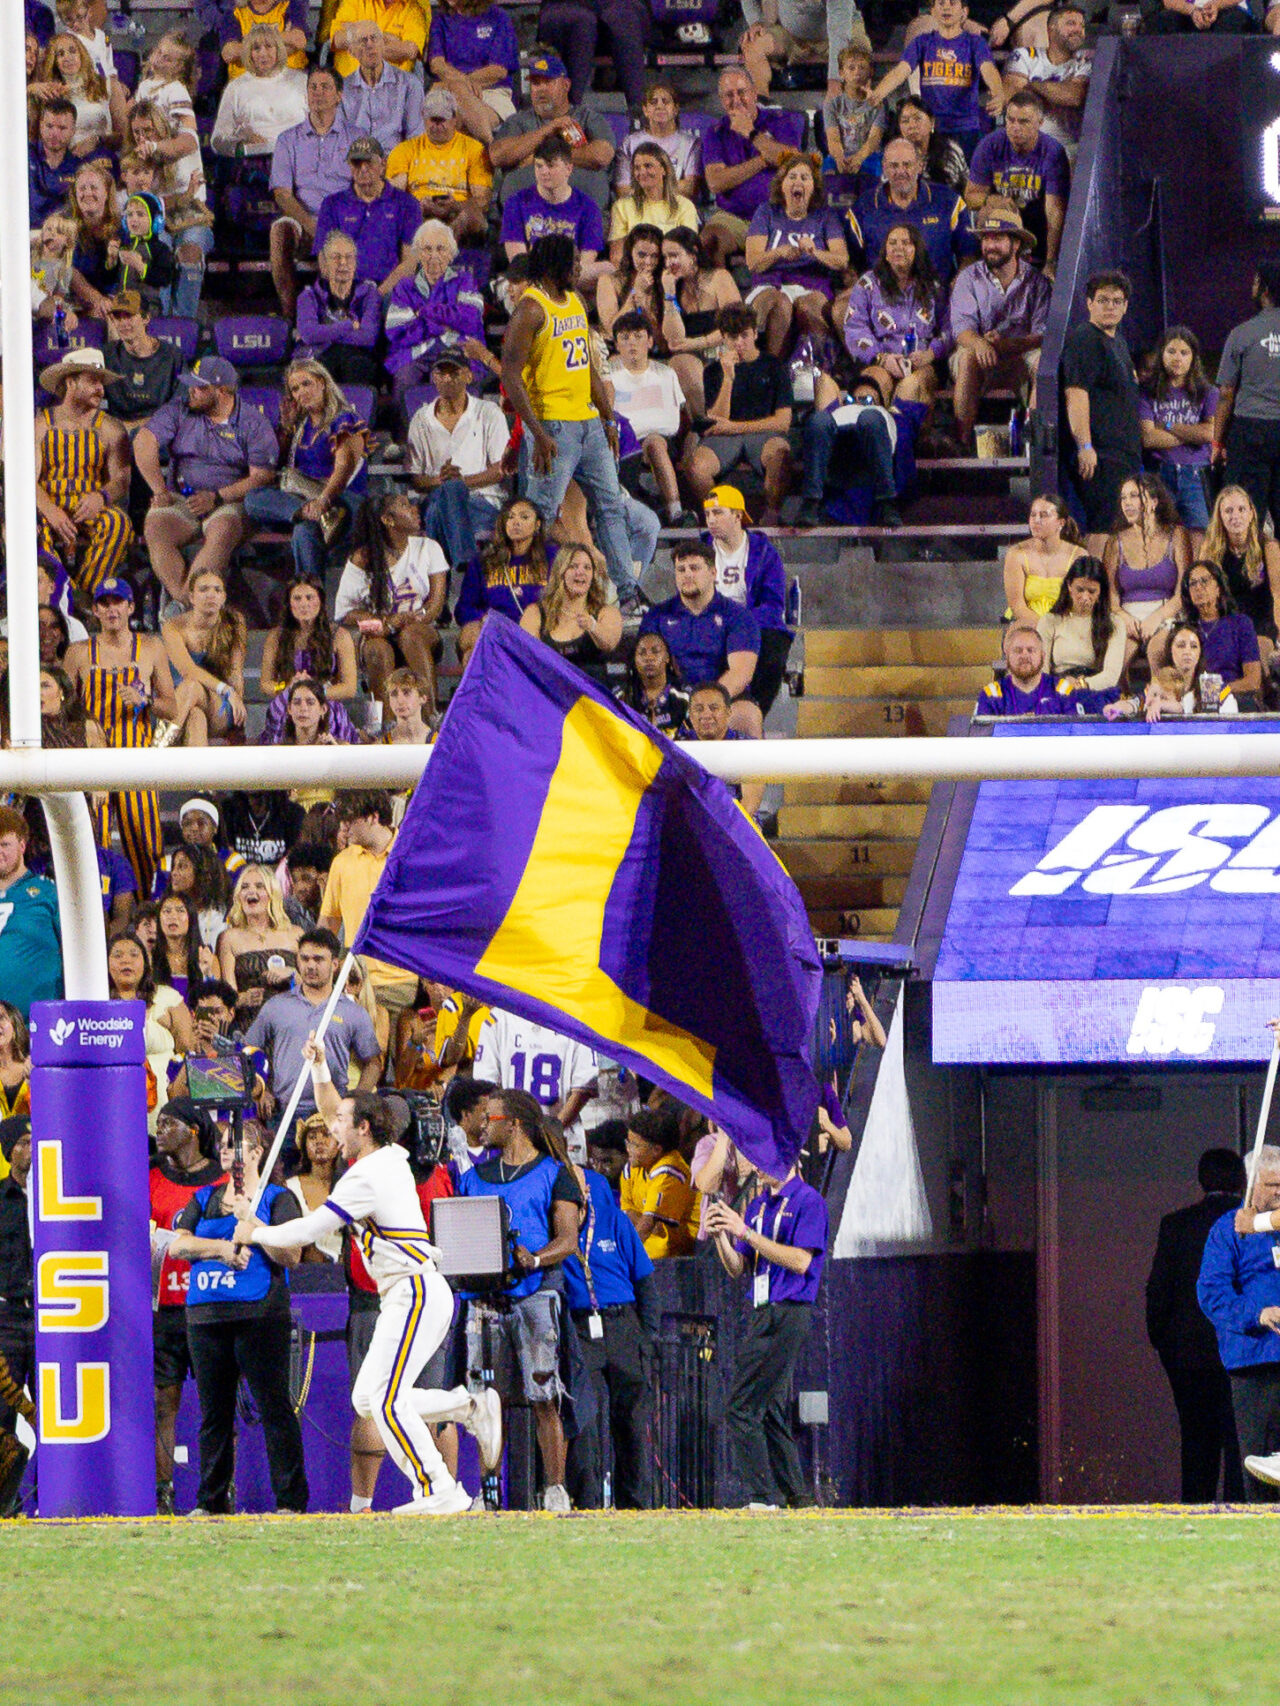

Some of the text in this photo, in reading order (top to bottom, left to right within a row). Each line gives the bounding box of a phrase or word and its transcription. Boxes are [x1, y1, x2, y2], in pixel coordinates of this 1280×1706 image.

[923, 61, 973, 79] TIGERS
[552, 312, 588, 339] LAKERS
[232, 333, 272, 349] LSU
[562, 336, 590, 372] 23
[884, 705, 906, 723] 13
[857, 846, 871, 865] 11
[477, 695, 719, 1099] L
[839, 913, 861, 935] 10
[77, 1017, 134, 1032] Woodside
[79, 1032, 124, 1049] Energy
[514, 1034, 522, 1048] C
[510, 1051, 562, 1106] 18
[196, 1270, 237, 1291] 074
[37, 1139, 111, 1445] LSU
